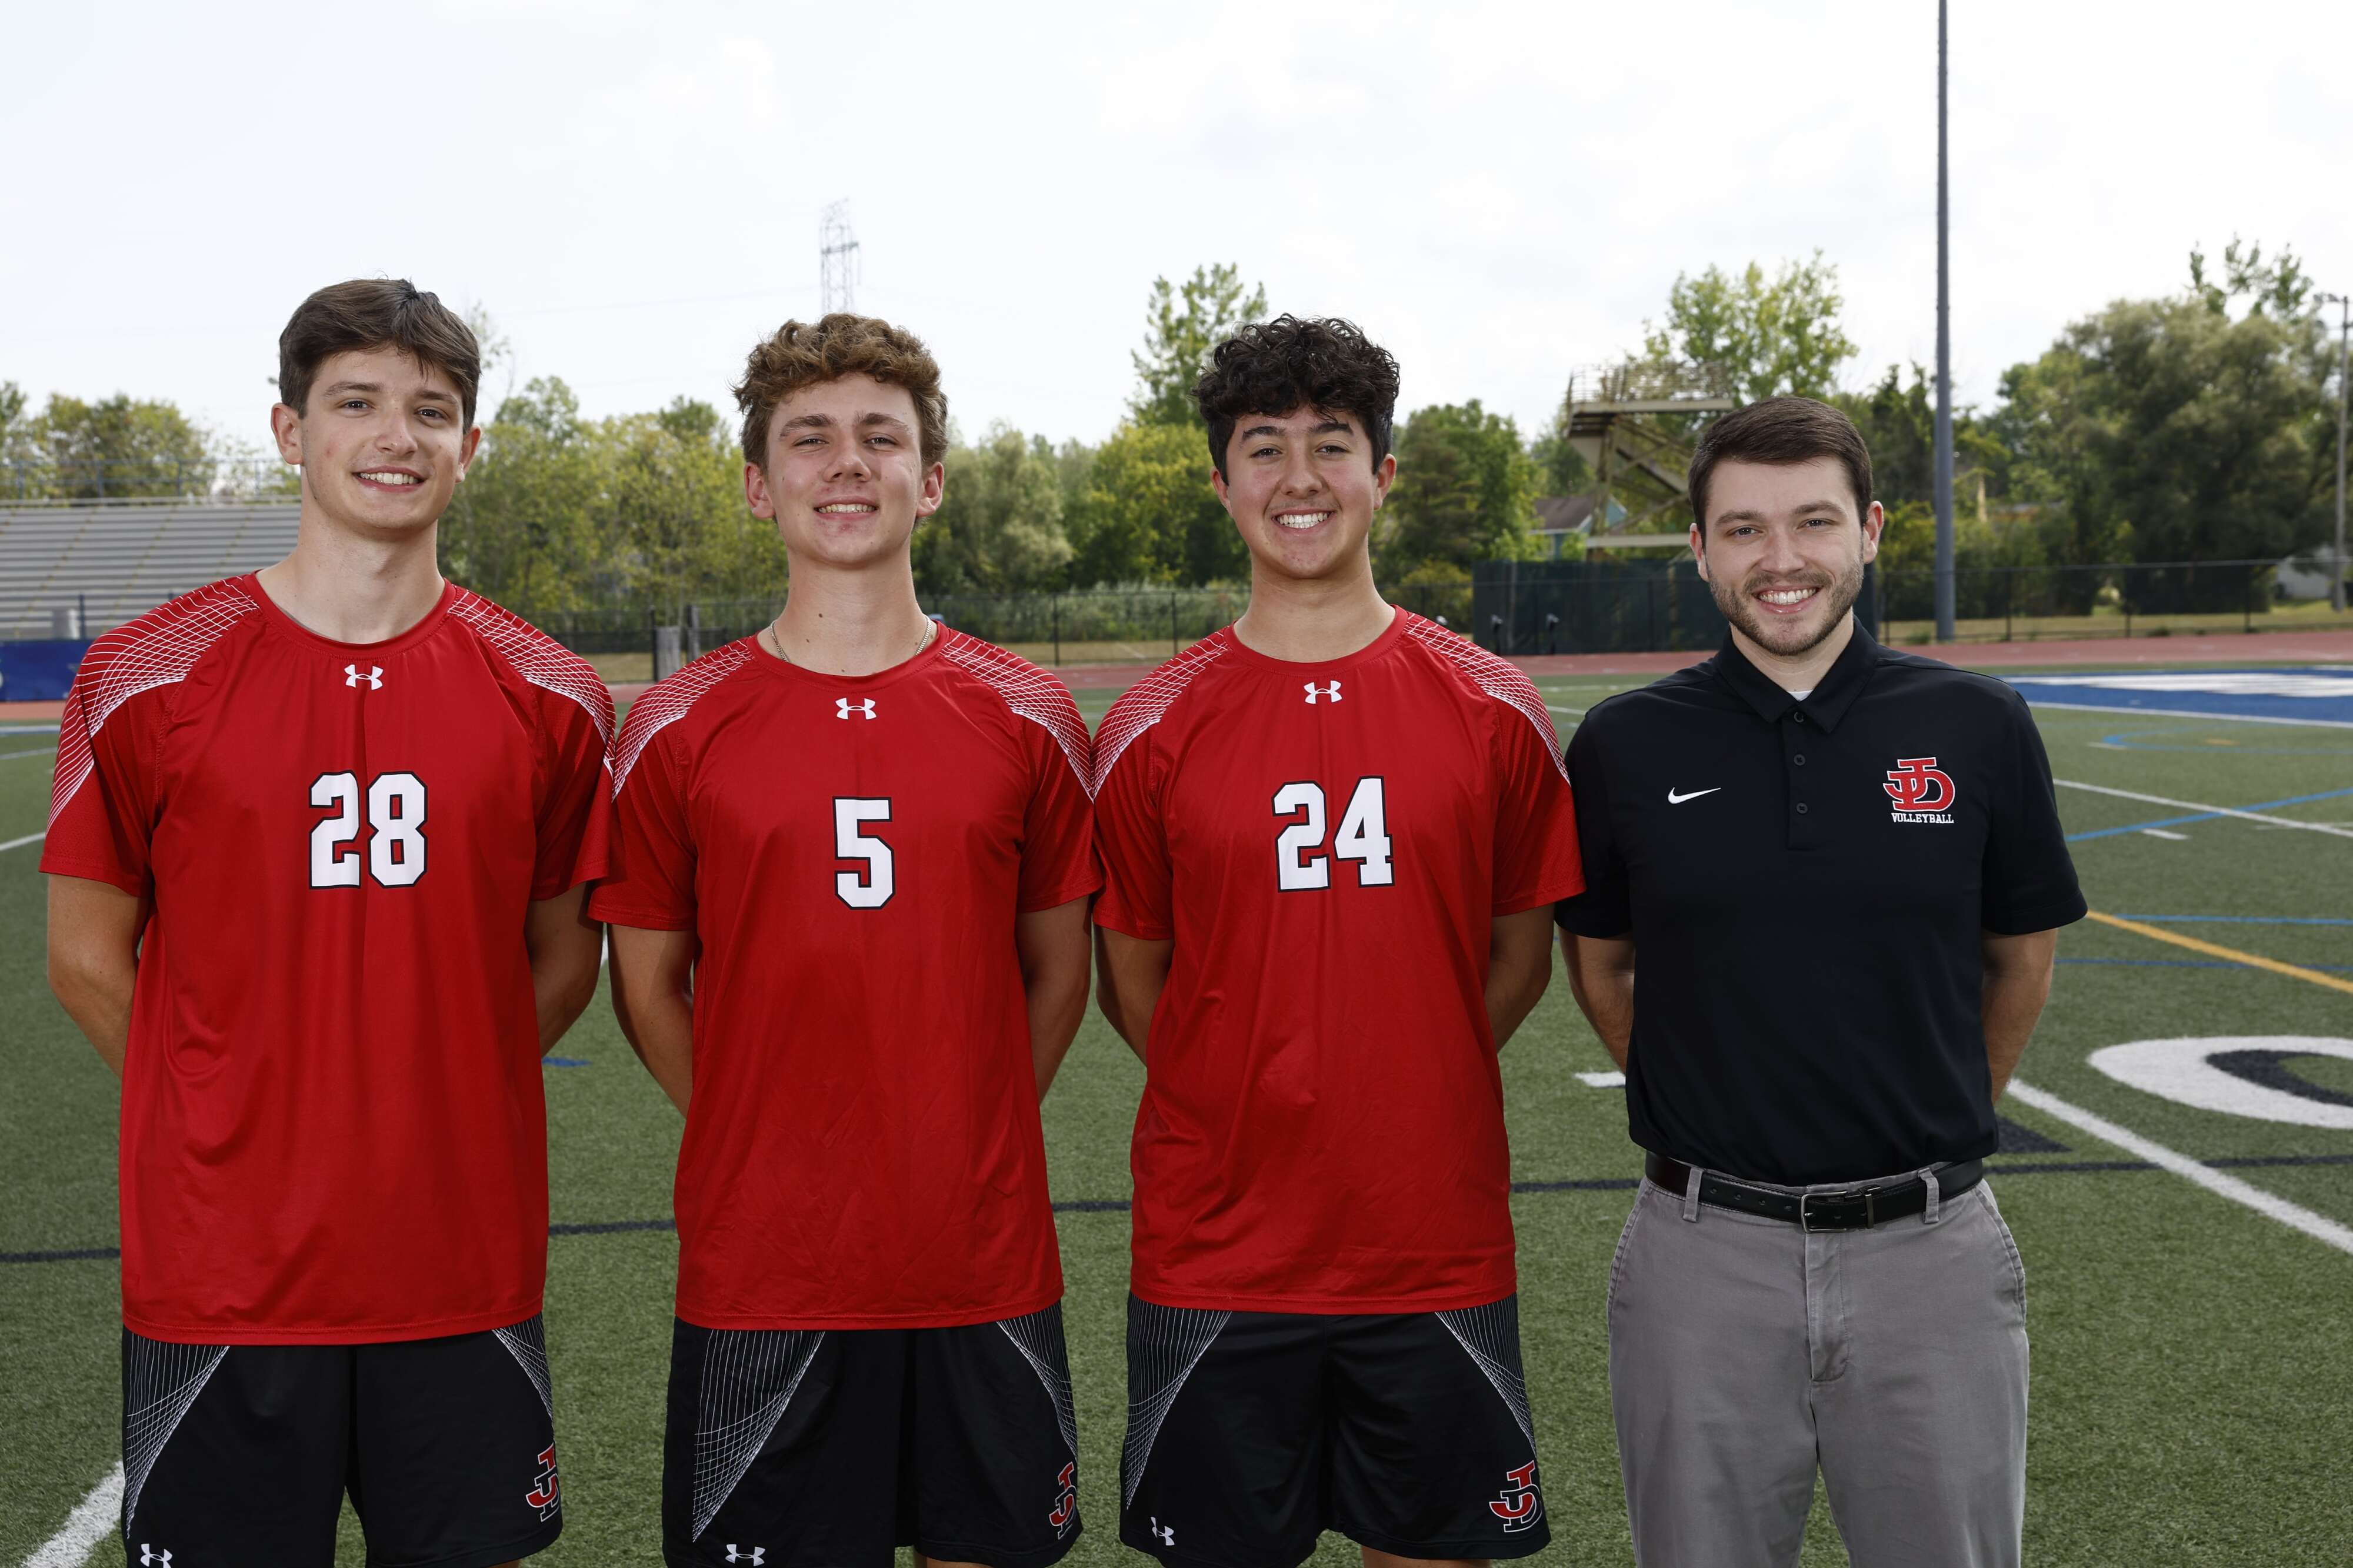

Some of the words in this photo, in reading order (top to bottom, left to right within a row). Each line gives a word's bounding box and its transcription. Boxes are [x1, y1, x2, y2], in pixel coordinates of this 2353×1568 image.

[308, 770, 428, 889] 28
[832, 796, 895, 910] 5
[1271, 775, 1395, 893] 24
[1891, 812, 1954, 823] VOLLEYBALL
